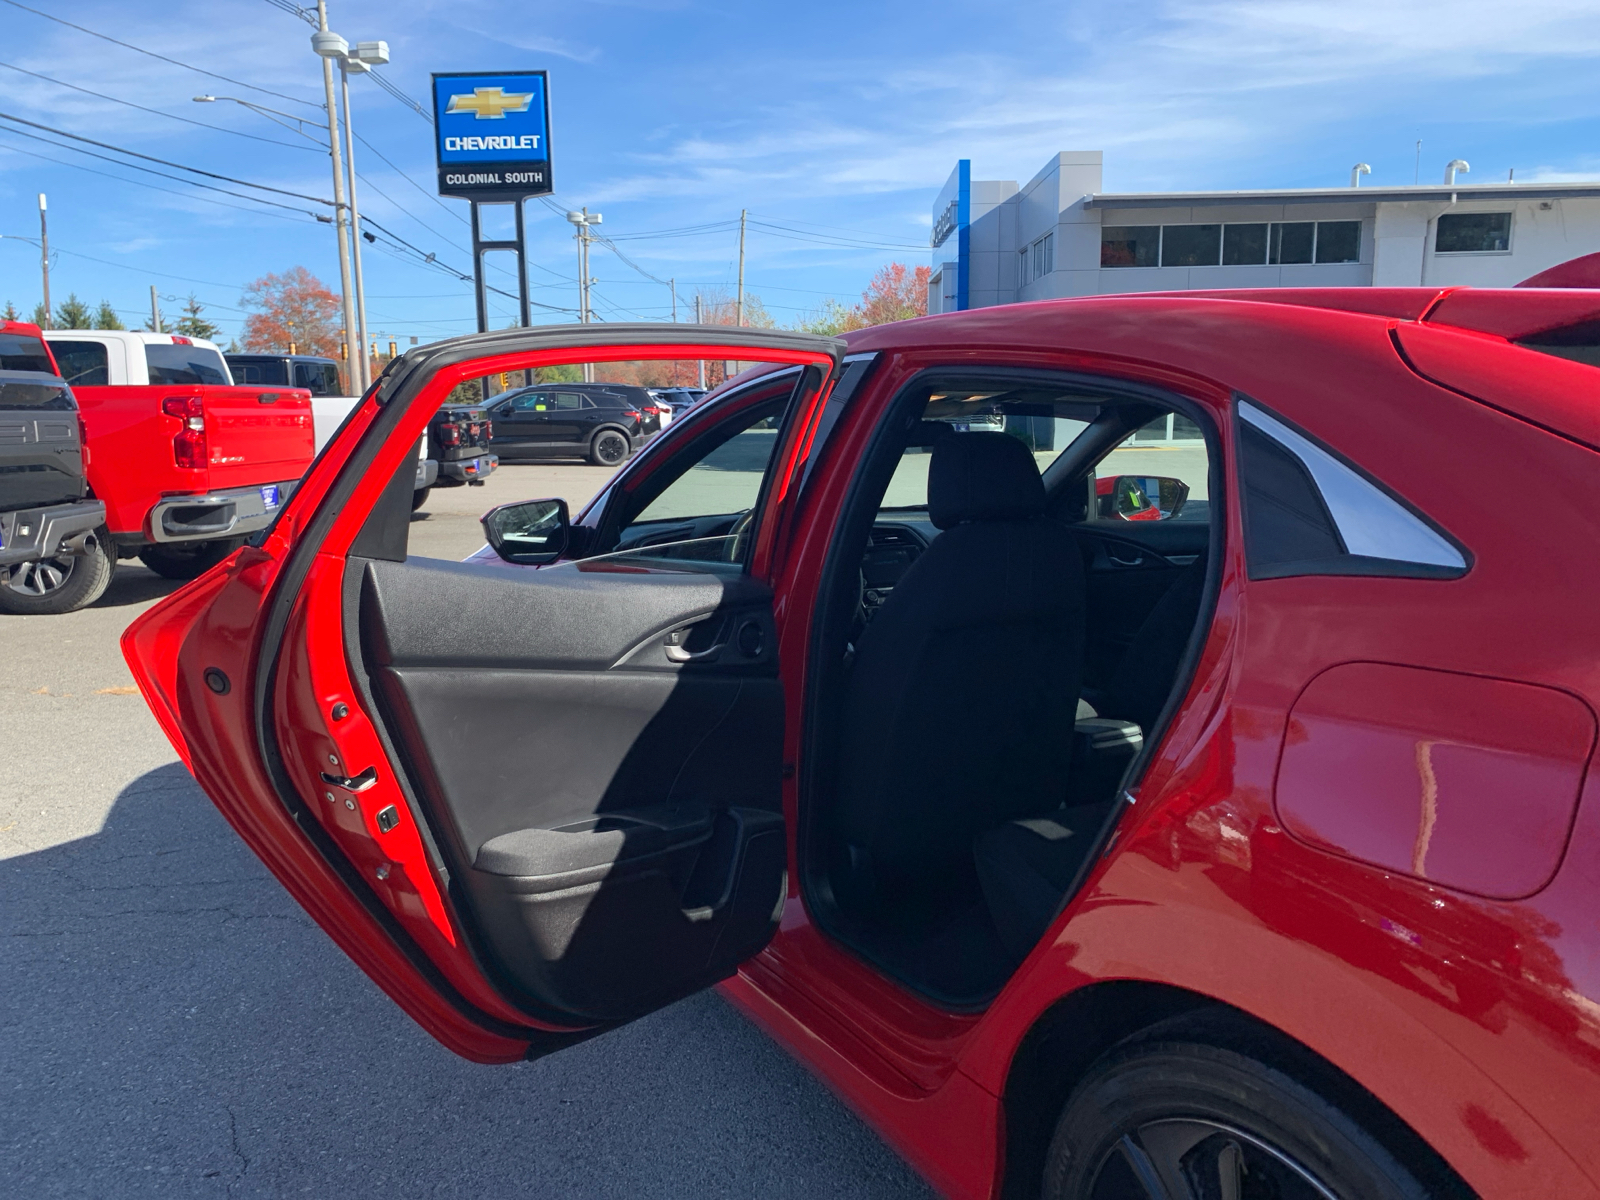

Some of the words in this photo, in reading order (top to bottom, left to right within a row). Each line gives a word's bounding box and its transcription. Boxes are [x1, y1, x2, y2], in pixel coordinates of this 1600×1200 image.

[445, 135, 540, 151] CHEVROLET
[446, 173, 502, 185] COLONIAL
[505, 172, 543, 184] SOUTH
